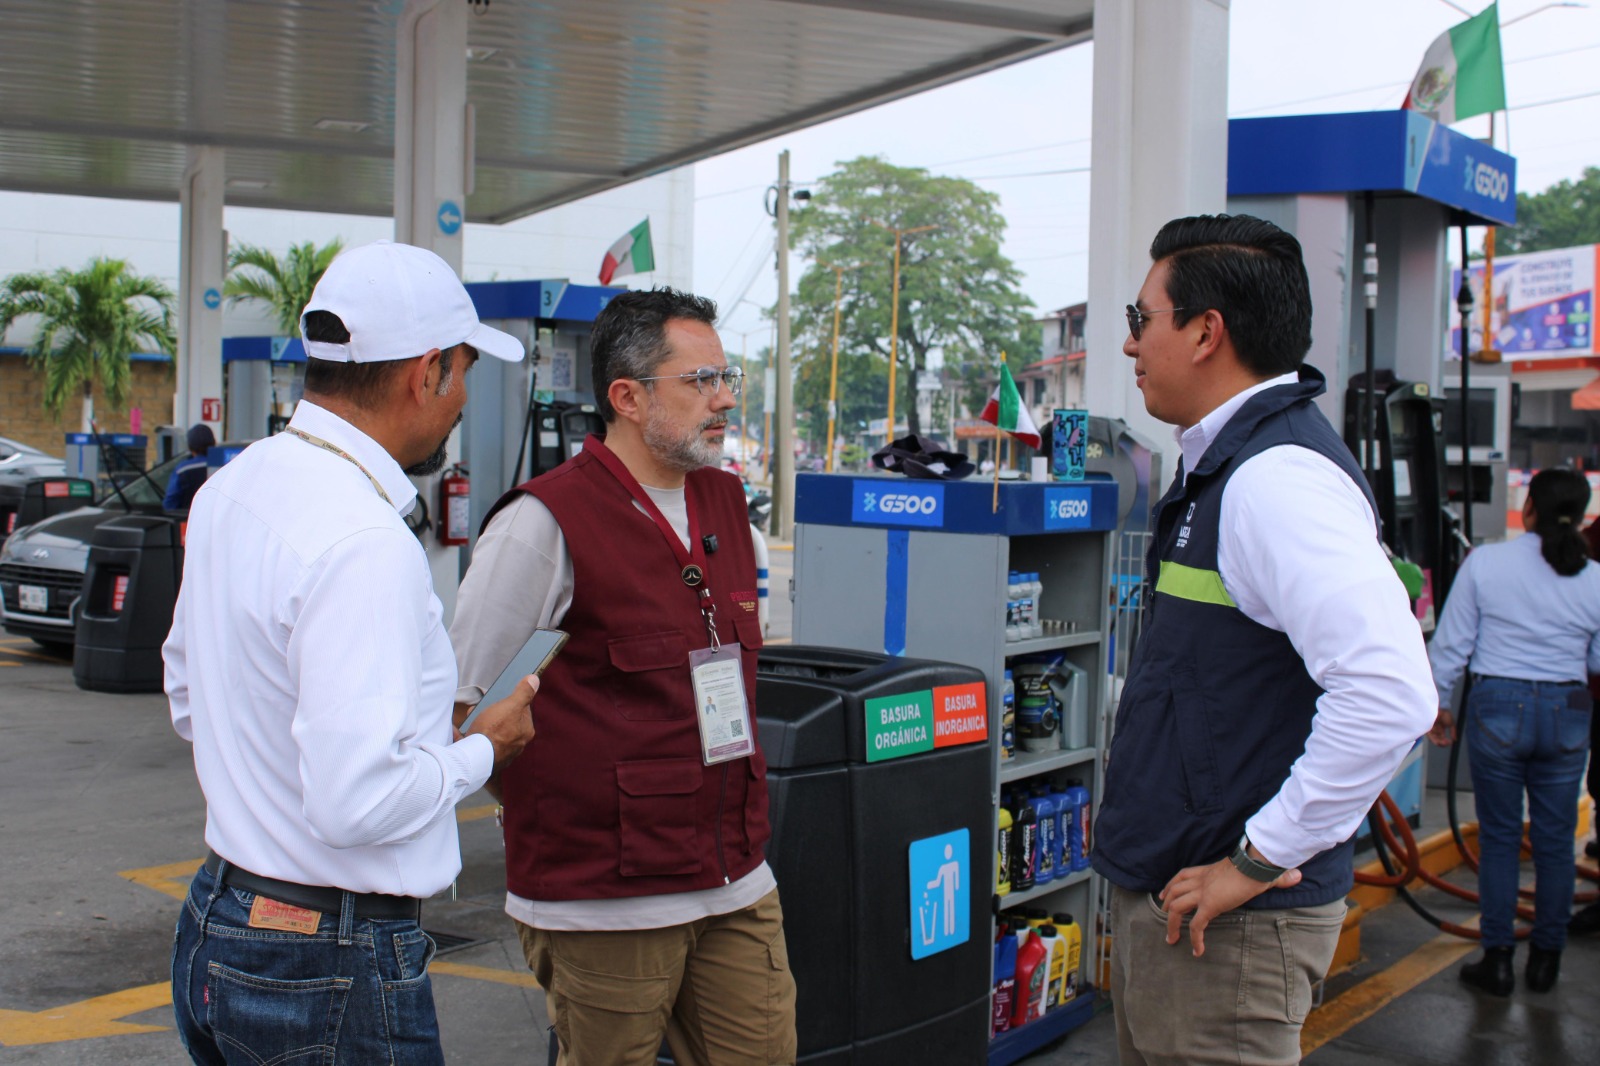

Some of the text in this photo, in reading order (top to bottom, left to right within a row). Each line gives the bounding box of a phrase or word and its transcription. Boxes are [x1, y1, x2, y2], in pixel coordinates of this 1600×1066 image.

[1410, 136, 1416, 168] 1
[1475, 163, 1509, 203] G500
[543, 290, 552, 306] 3
[879, 493, 937, 515] G500
[1058, 500, 1088, 518] G500
[880, 703, 921, 725] BASURA
[944, 693, 977, 713] BASURA
[936, 715, 986, 737] INORGANICA
[875, 725, 927, 750] ORGÁNICA
